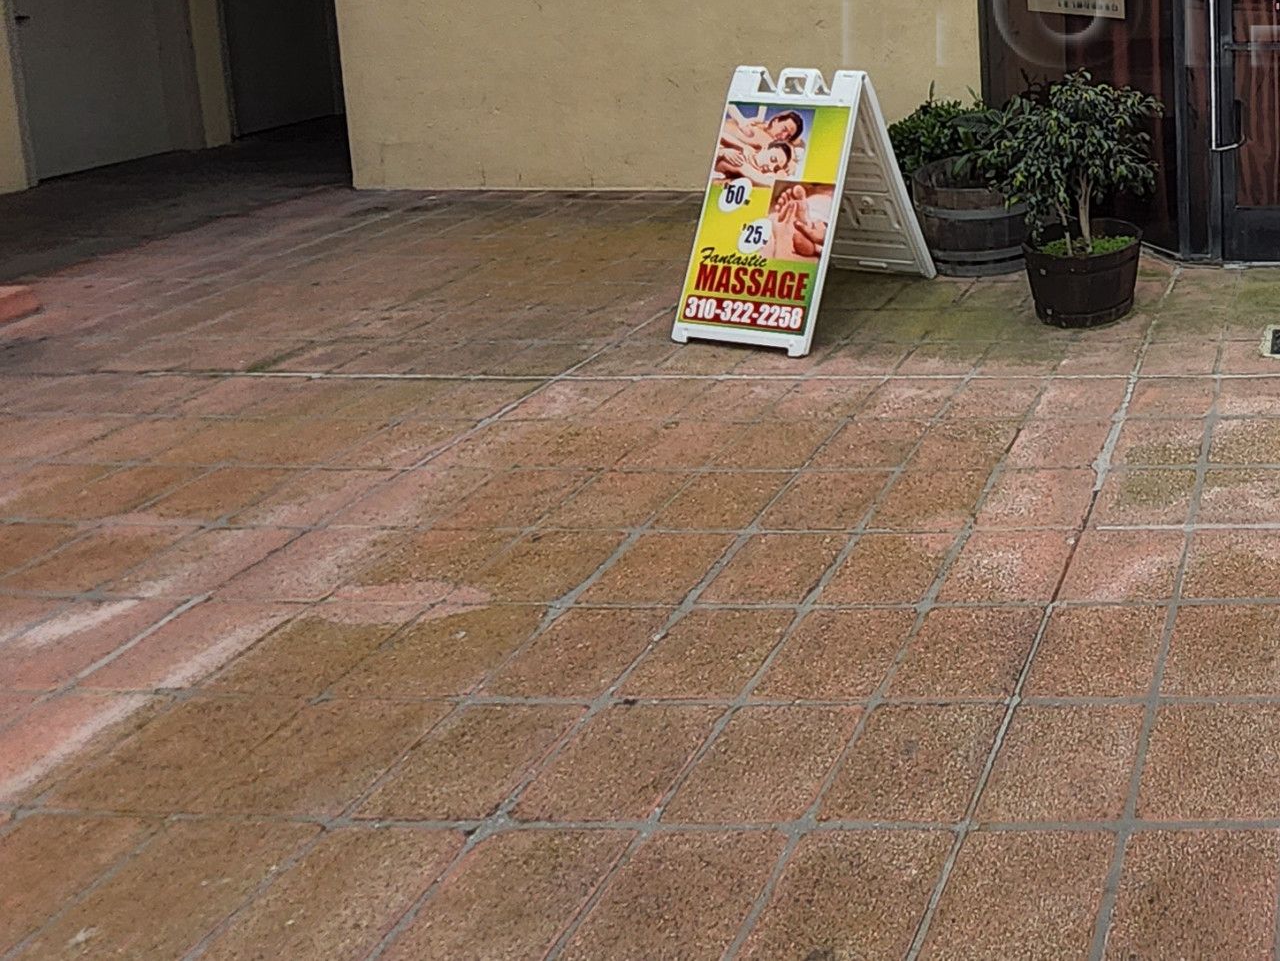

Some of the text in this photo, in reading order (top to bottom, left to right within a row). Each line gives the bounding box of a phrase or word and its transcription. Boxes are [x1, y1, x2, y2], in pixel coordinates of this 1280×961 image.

[700, 247, 767, 268] Fantastic
[694, 264, 809, 302] MASSAGE
[685, 296, 804, 329] 310-322-2258
